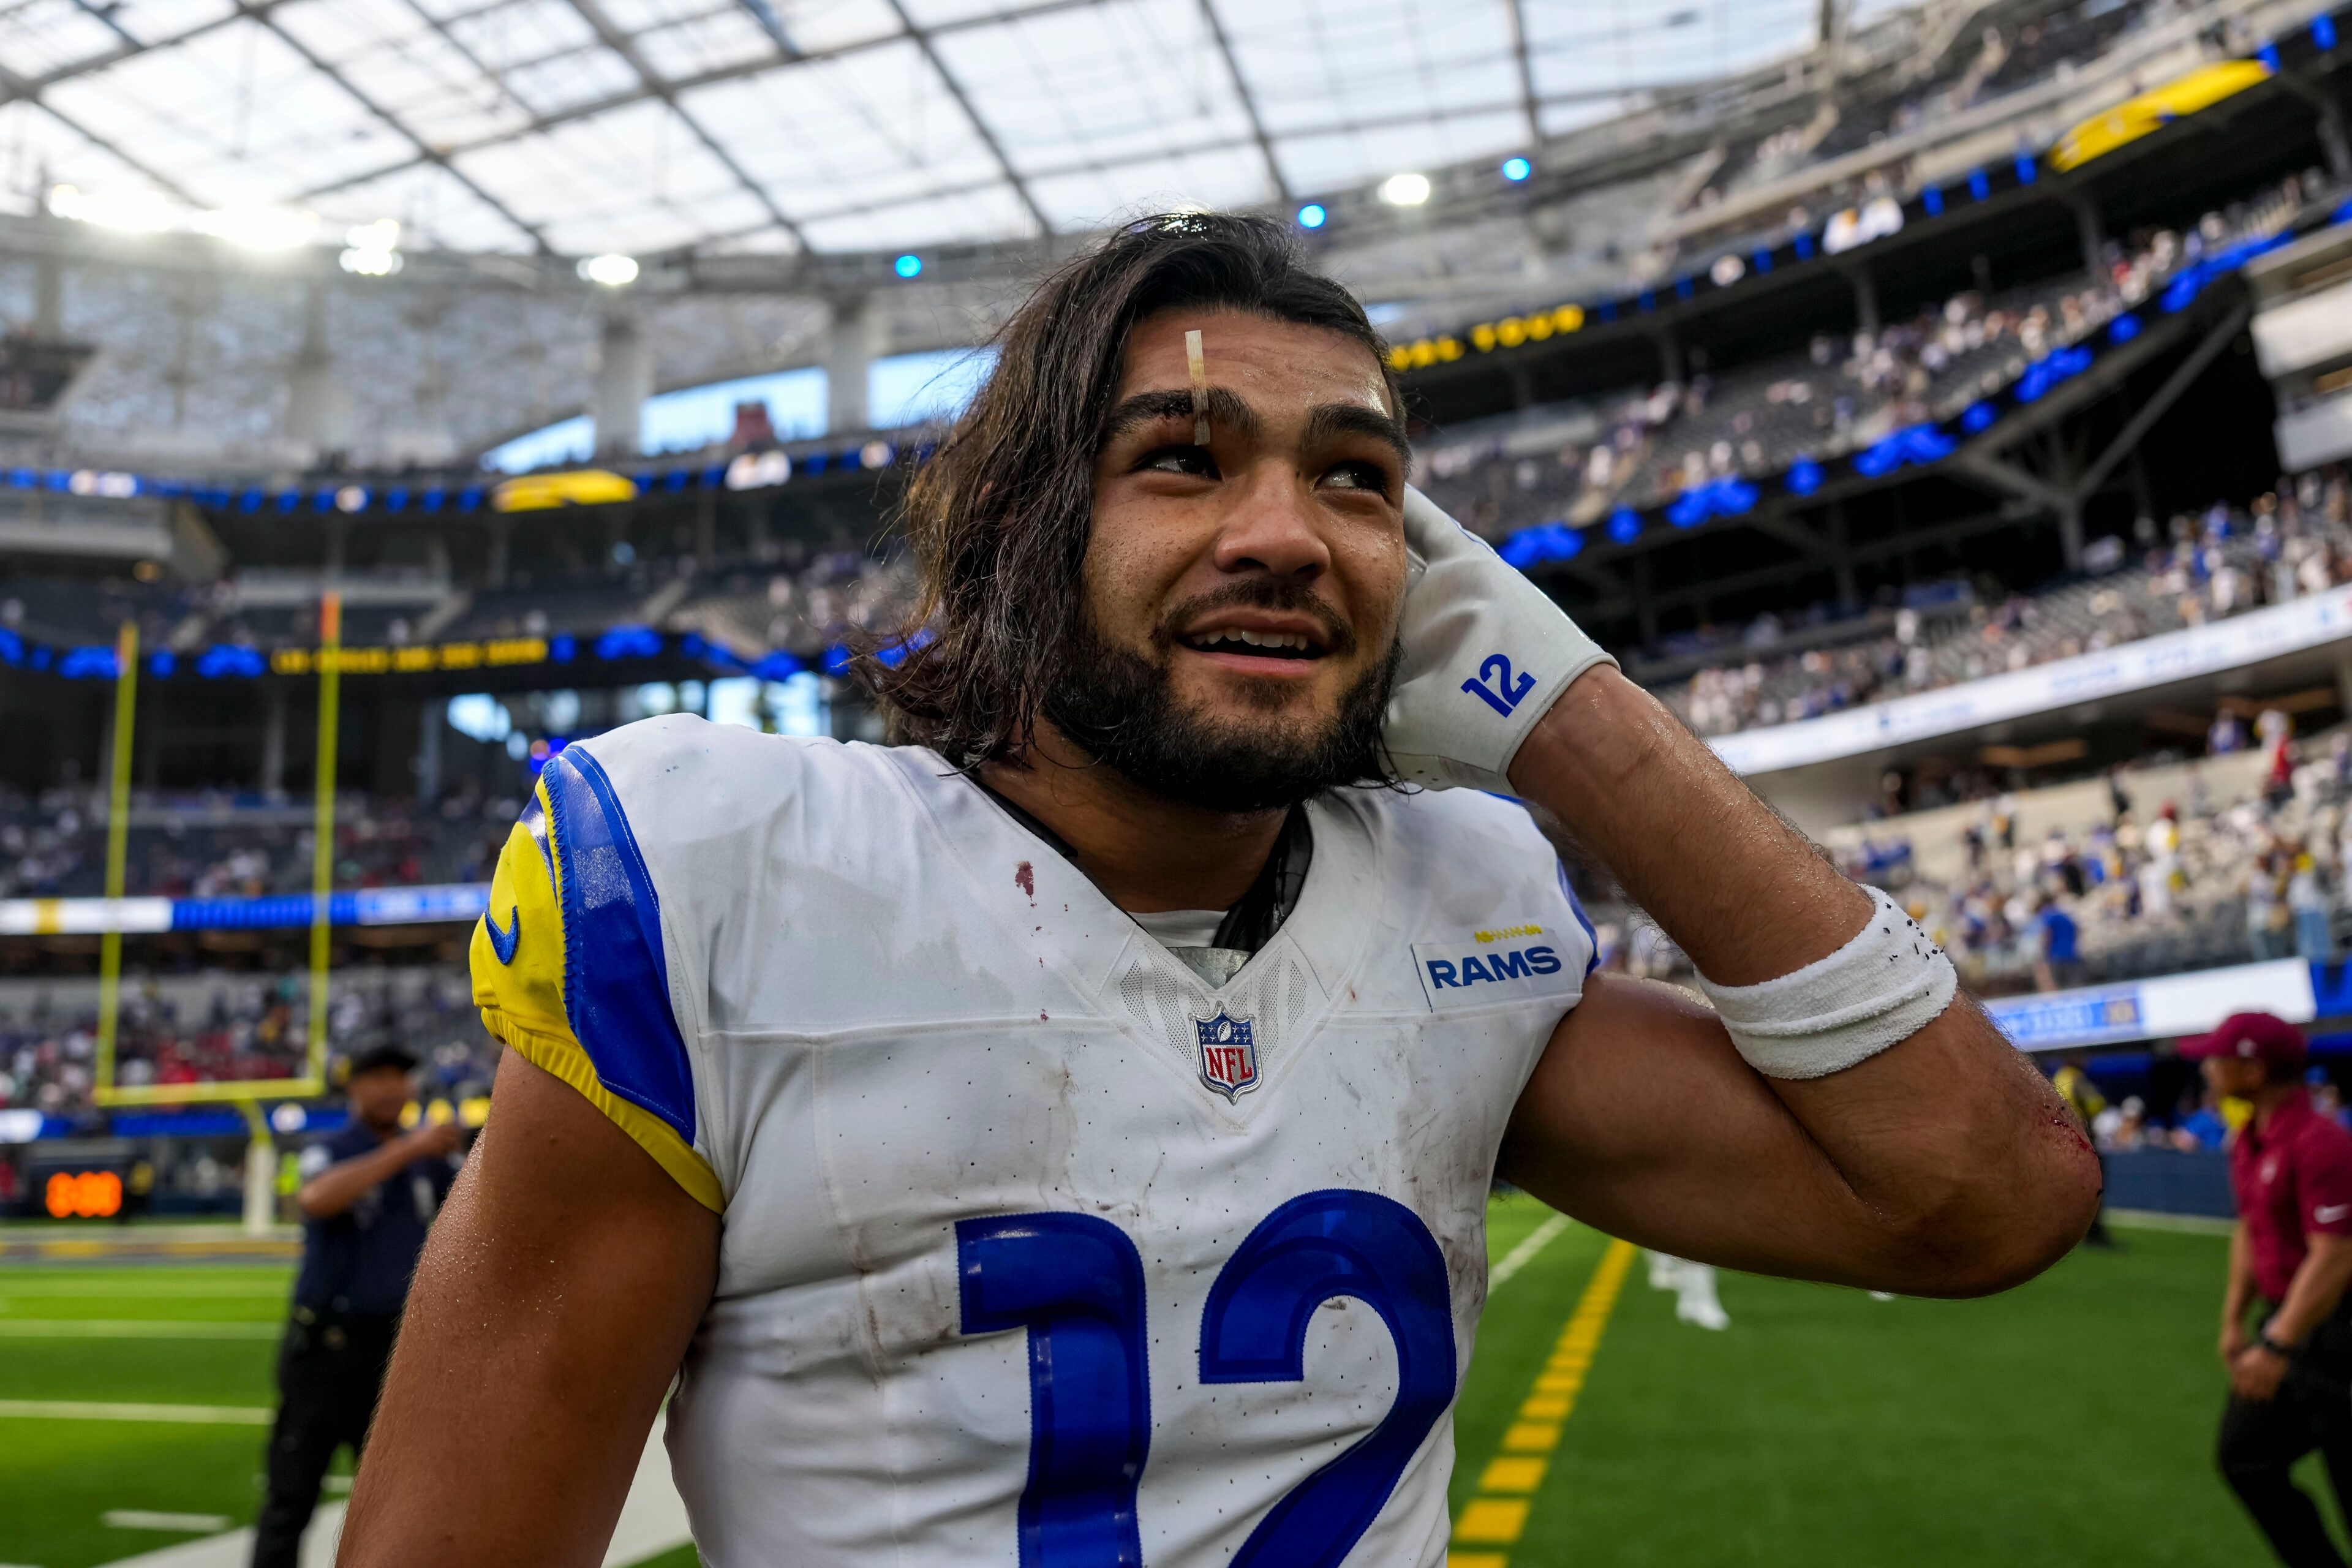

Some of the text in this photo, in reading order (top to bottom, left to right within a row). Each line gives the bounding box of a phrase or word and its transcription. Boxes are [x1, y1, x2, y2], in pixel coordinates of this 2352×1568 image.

[1460, 653, 1537, 718] 12
[1427, 946, 1561, 989] RAMS
[1205, 1047, 1253, 1084] NFL
[955, 1188, 1457, 1568] 12
